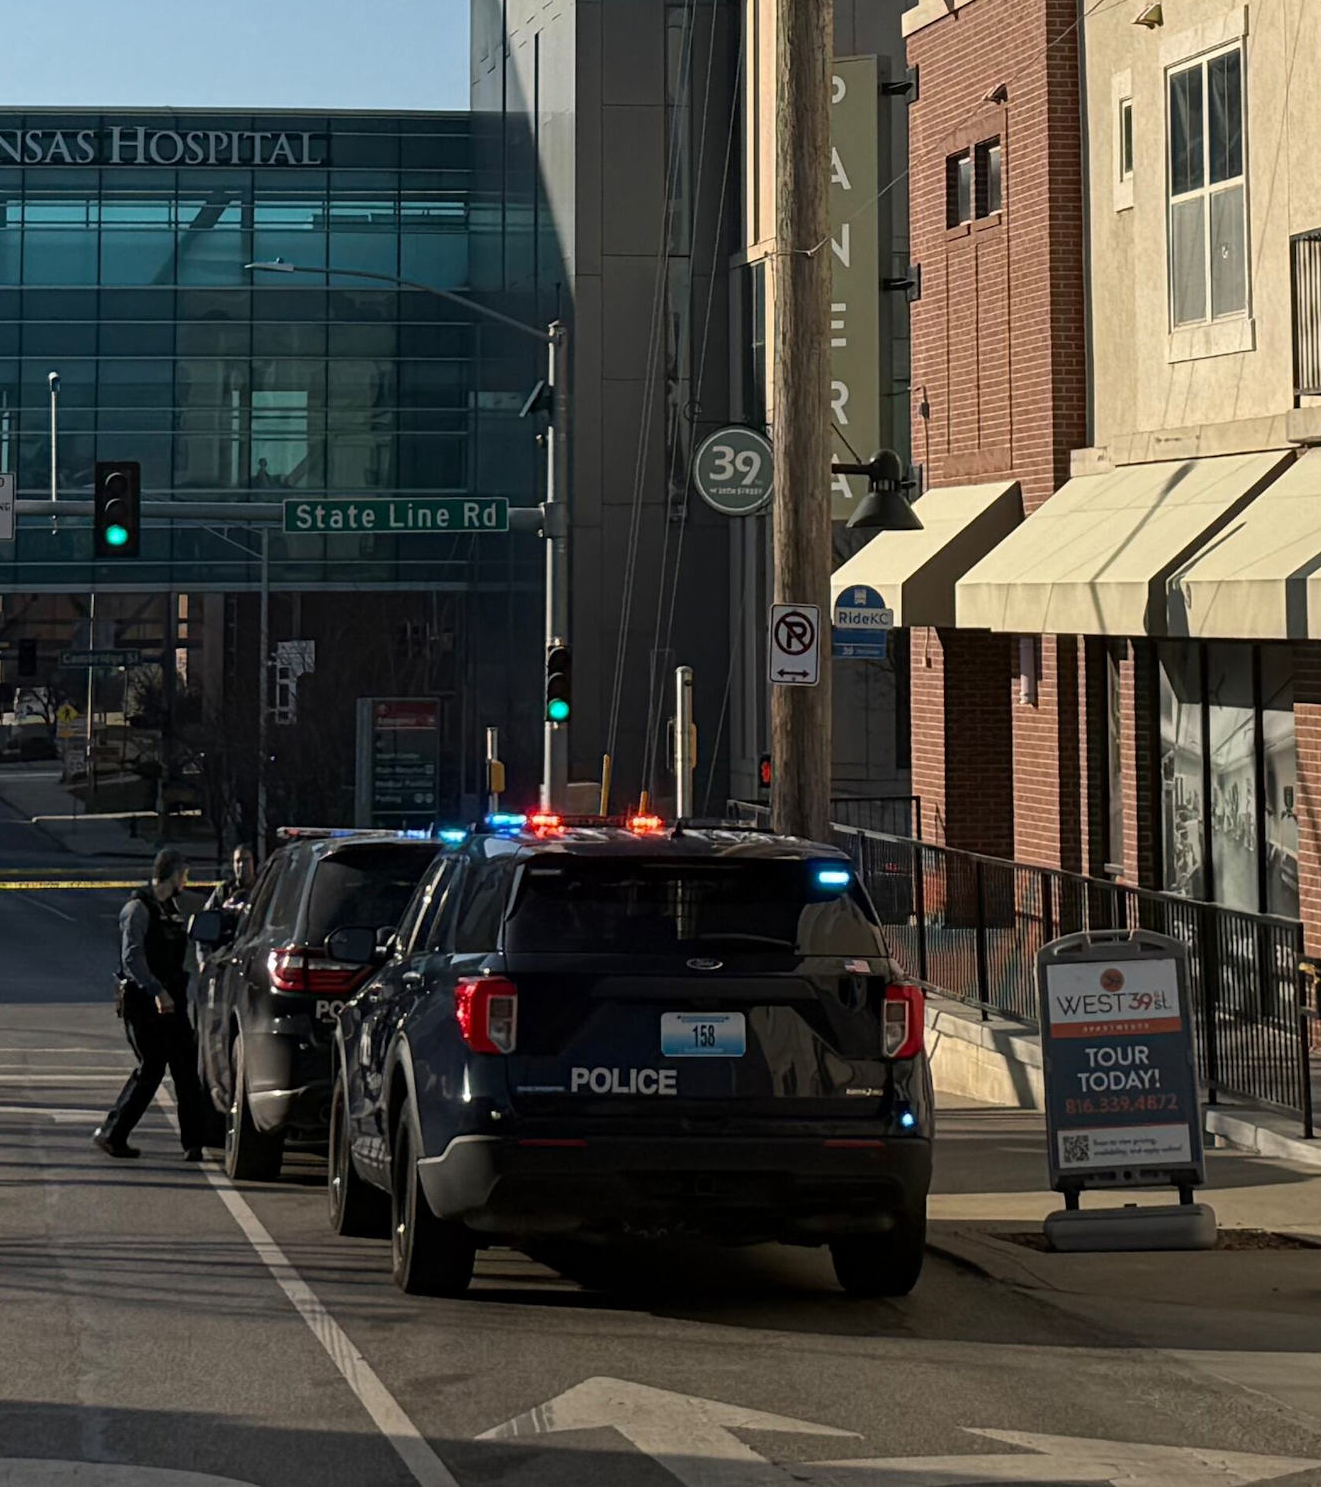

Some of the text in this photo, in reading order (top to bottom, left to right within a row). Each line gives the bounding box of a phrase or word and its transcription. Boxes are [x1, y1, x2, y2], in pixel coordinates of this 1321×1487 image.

[109, 125, 323, 166] HOSPITAL
[709, 445, 762, 486] 39
[296, 502, 497, 529] State Line Rd
[838, 611, 889, 626] RideKC
[1057, 993, 1126, 1016] WEST
[692, 1025, 716, 1048] 158
[1085, 1045, 1149, 1068] TOUR
[570, 1066, 679, 1097] POLICE
[1077, 1068, 1161, 1092] TODAY!
[1065, 1093, 1179, 1115] 816.339.4872
